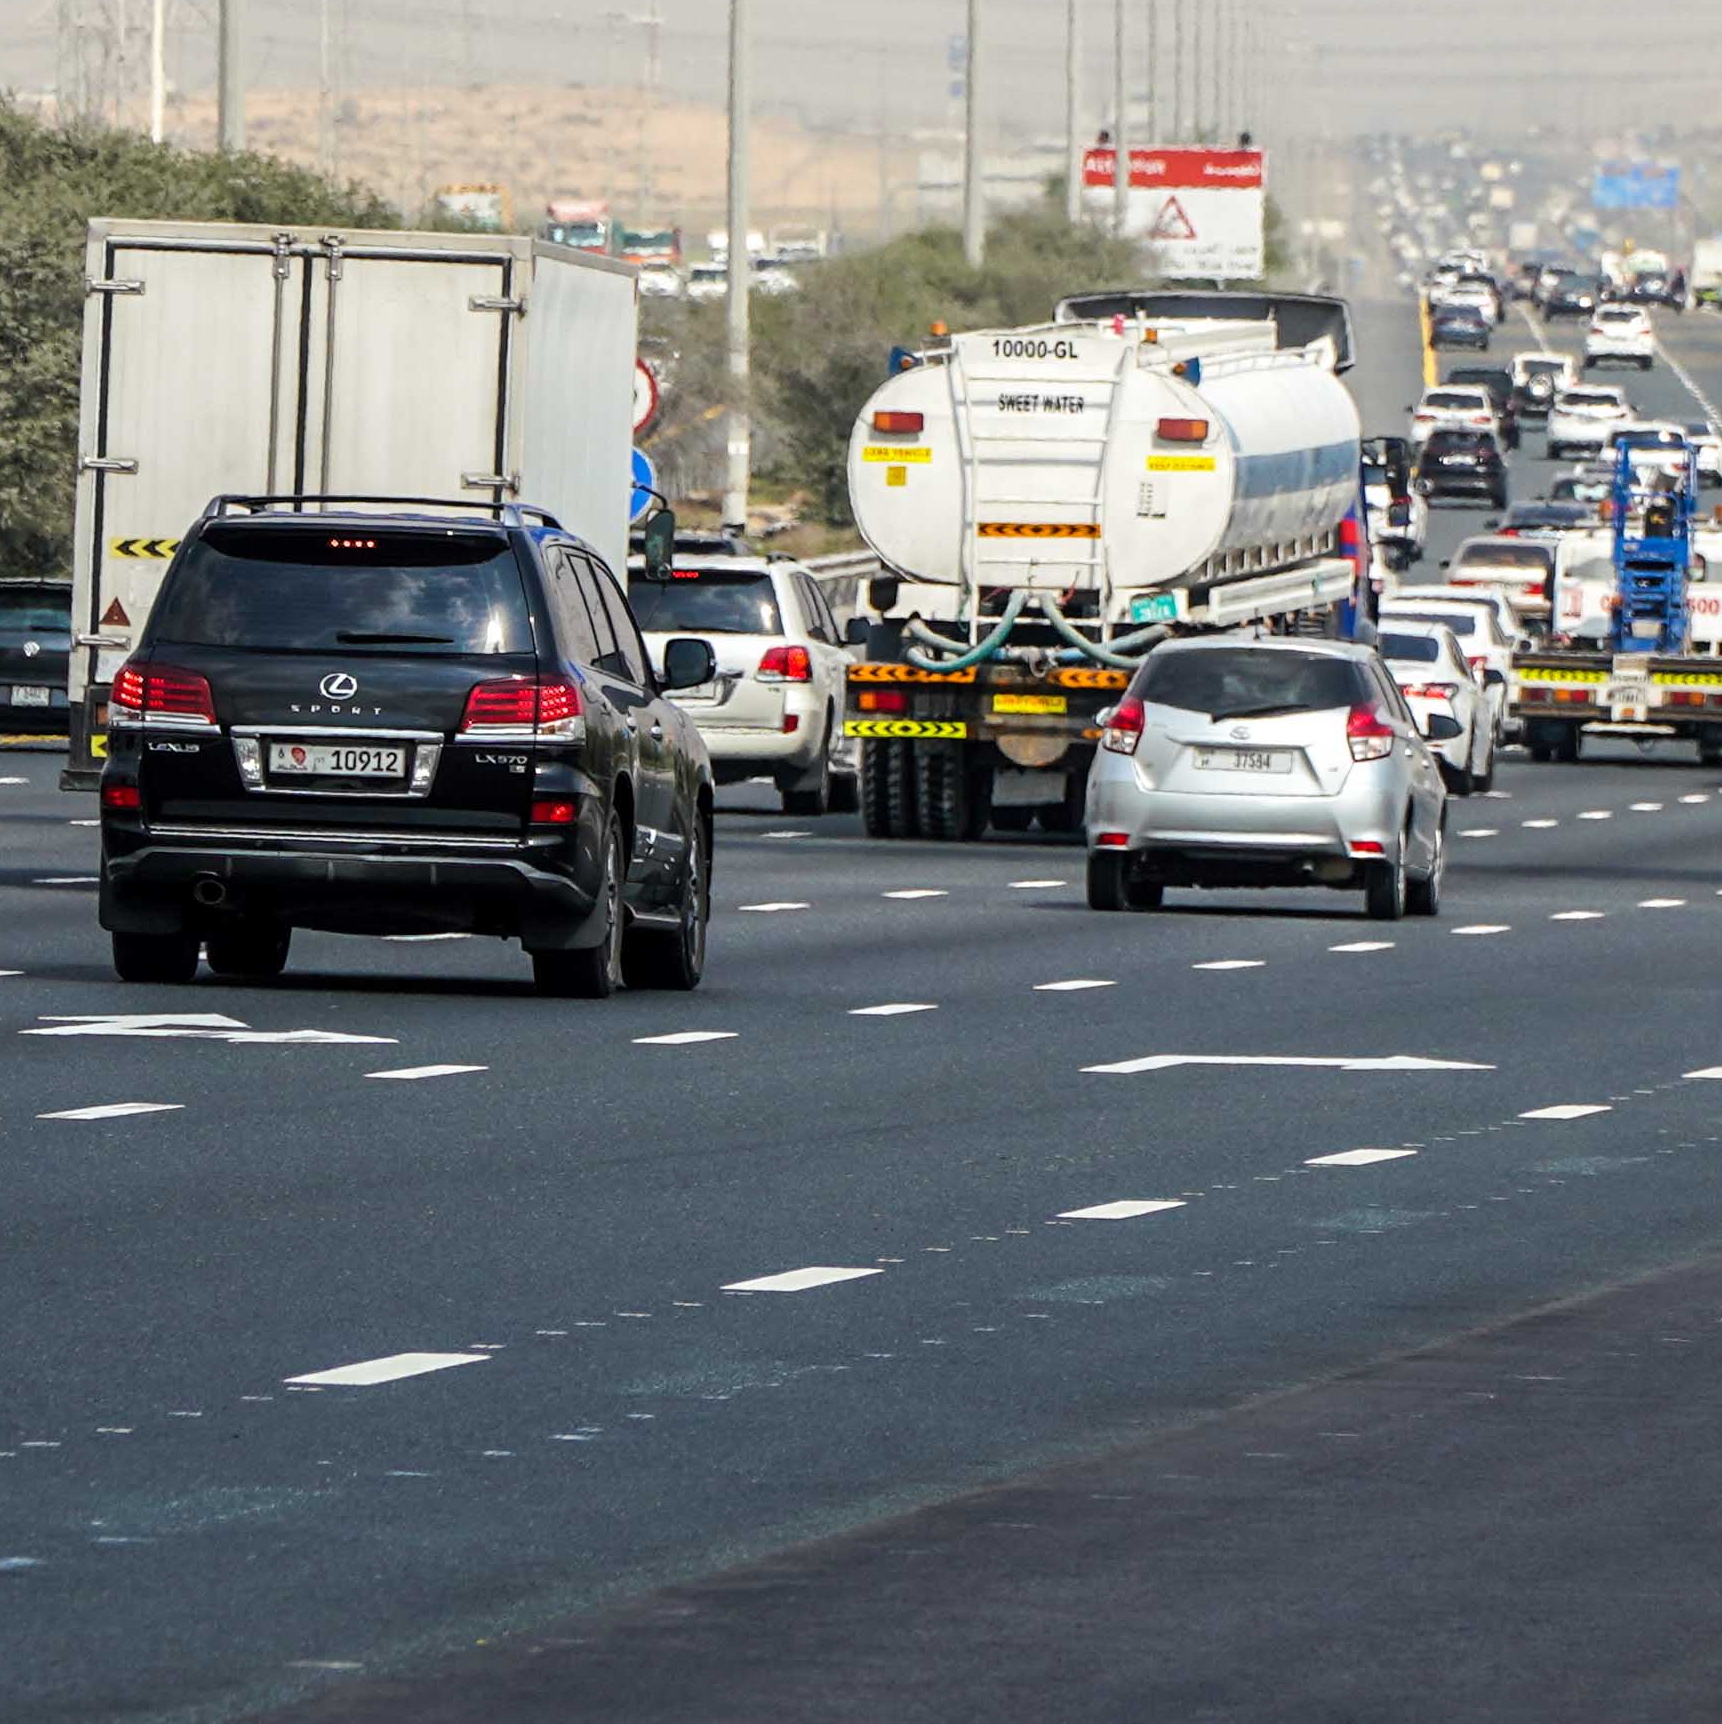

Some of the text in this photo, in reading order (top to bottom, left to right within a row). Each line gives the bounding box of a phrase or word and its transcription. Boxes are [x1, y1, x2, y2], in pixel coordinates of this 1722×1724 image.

[992, 339, 1079, 359] 10000-GL
[997, 392, 1086, 415] SWEET WATER
[290, 703, 383, 715] SPORT
[148, 741, 200, 753] LEXUS
[330, 749, 398, 773] 10912
